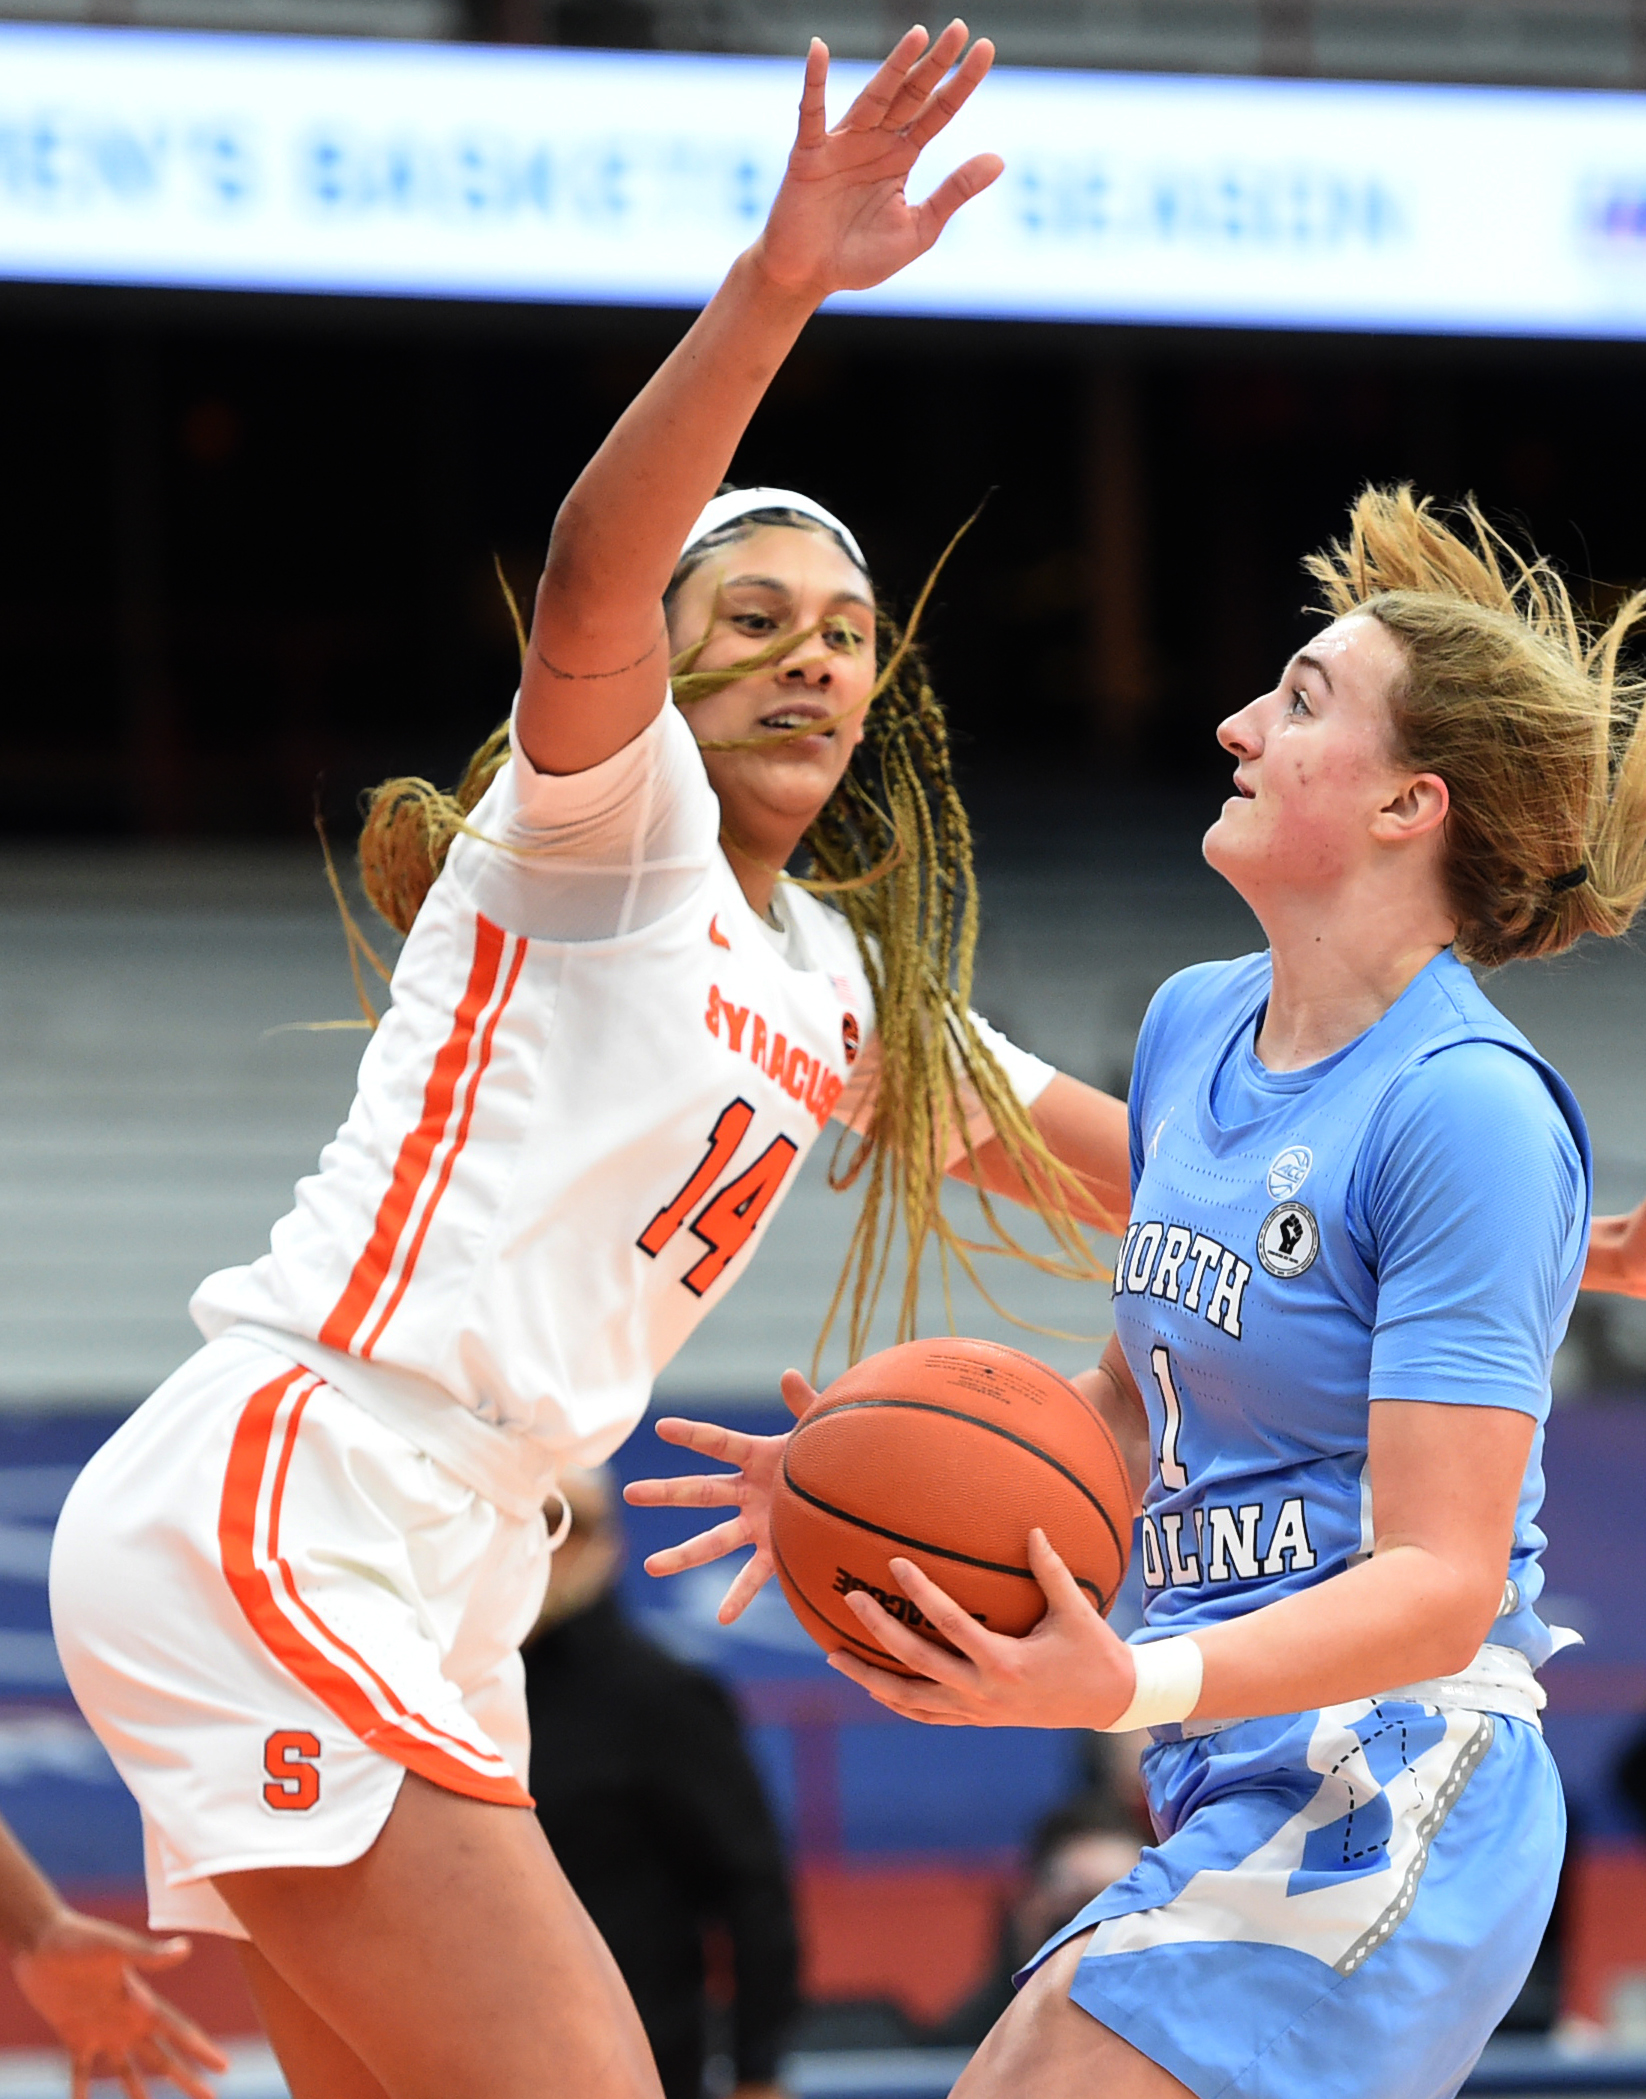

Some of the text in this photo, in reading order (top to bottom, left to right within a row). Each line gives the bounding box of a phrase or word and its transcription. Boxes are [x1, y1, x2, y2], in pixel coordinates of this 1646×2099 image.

[705, 984, 844, 1131] SYRACUS
[636, 1096, 799, 1298] 14
[1113, 1220, 1252, 1341] NORTH
[1150, 1344, 1189, 1492] 1
[263, 1729, 321, 1810] S
